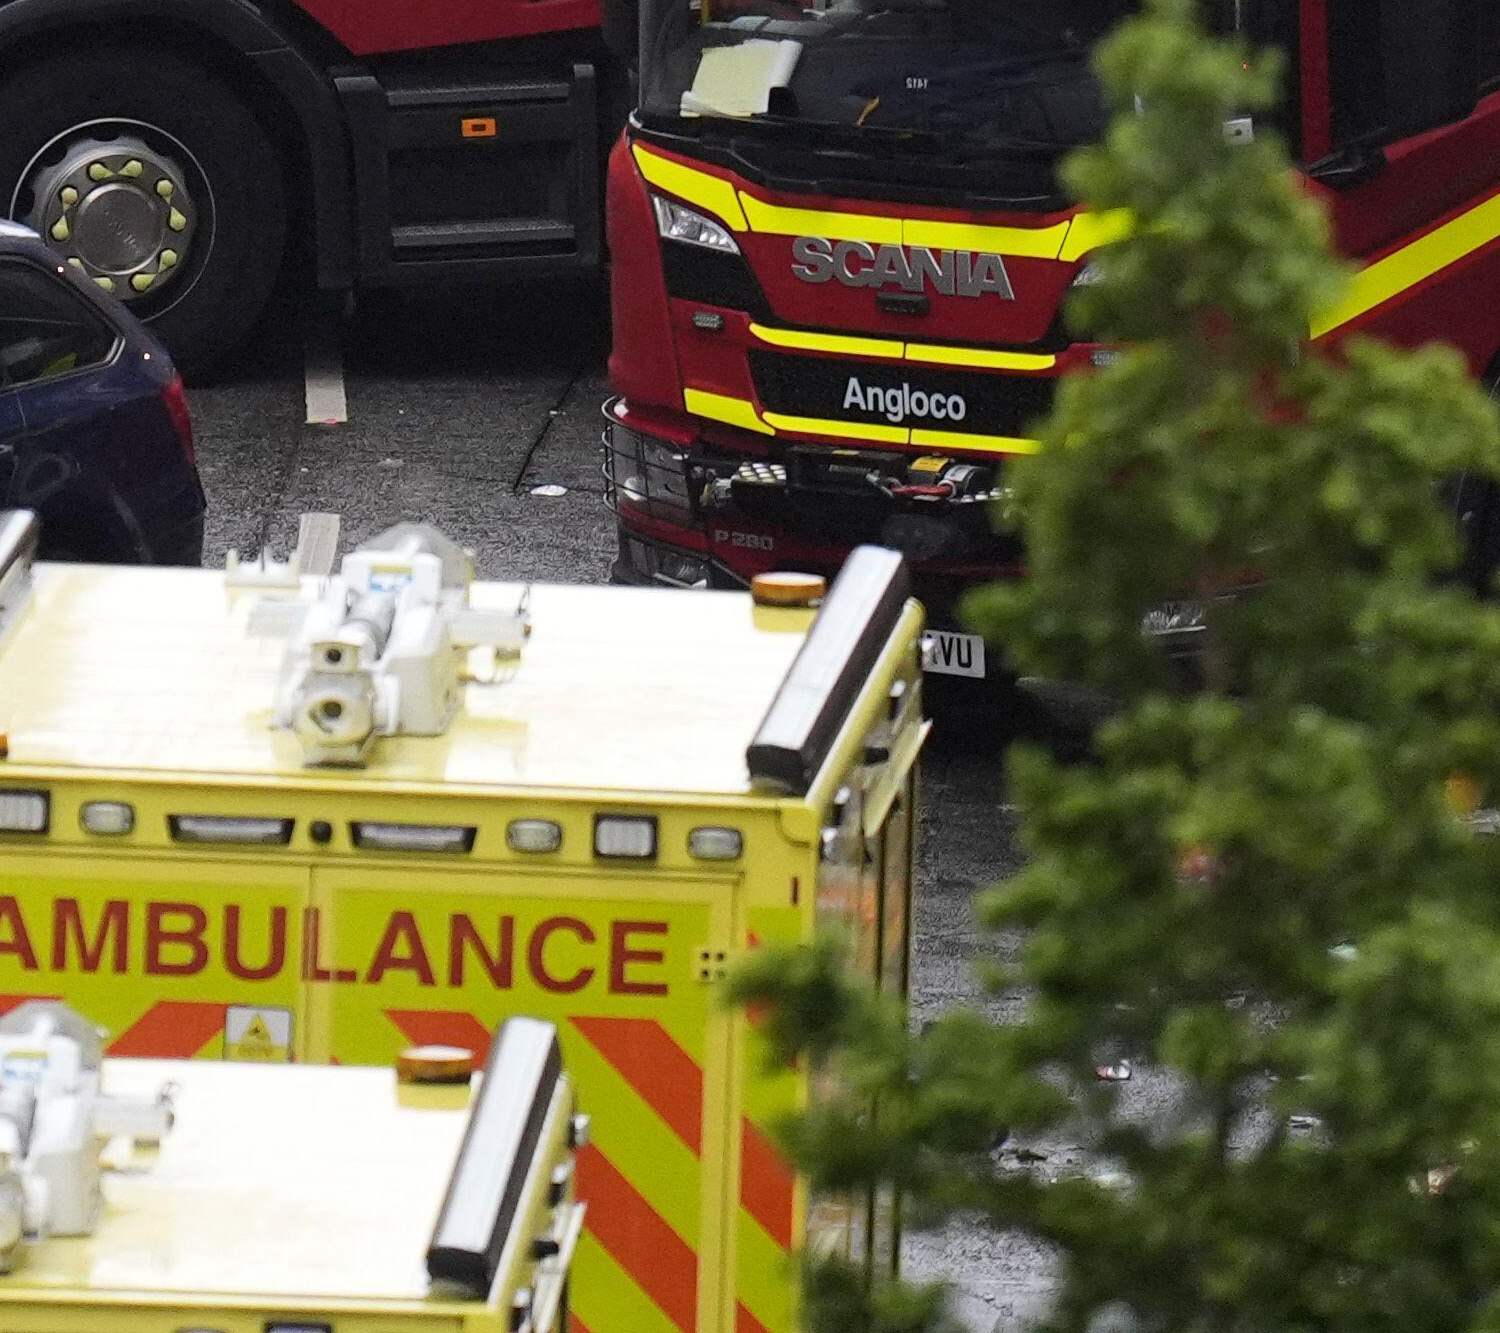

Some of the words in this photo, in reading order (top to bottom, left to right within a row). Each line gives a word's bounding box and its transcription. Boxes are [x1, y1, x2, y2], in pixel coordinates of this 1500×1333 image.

[791, 234, 1016, 301] SCANIA
[843, 377, 966, 422] Angloco
[715, 529, 730, 543] P
[732, 531, 774, 551] 280
